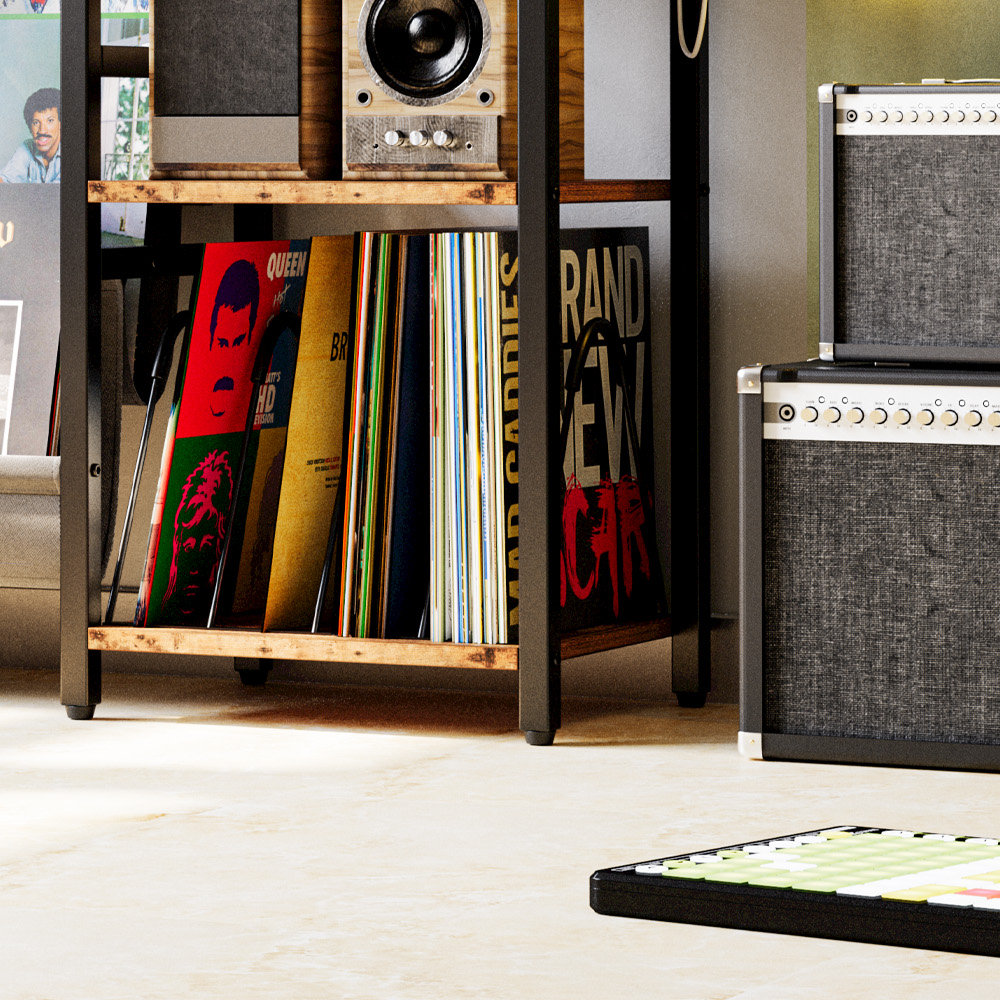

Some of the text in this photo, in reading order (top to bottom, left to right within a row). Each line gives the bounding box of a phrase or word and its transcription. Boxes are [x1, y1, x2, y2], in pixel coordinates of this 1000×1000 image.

[267, 251, 307, 281] QUEEN
[560, 244, 646, 344] RAND
[560, 472, 652, 620] CAR
